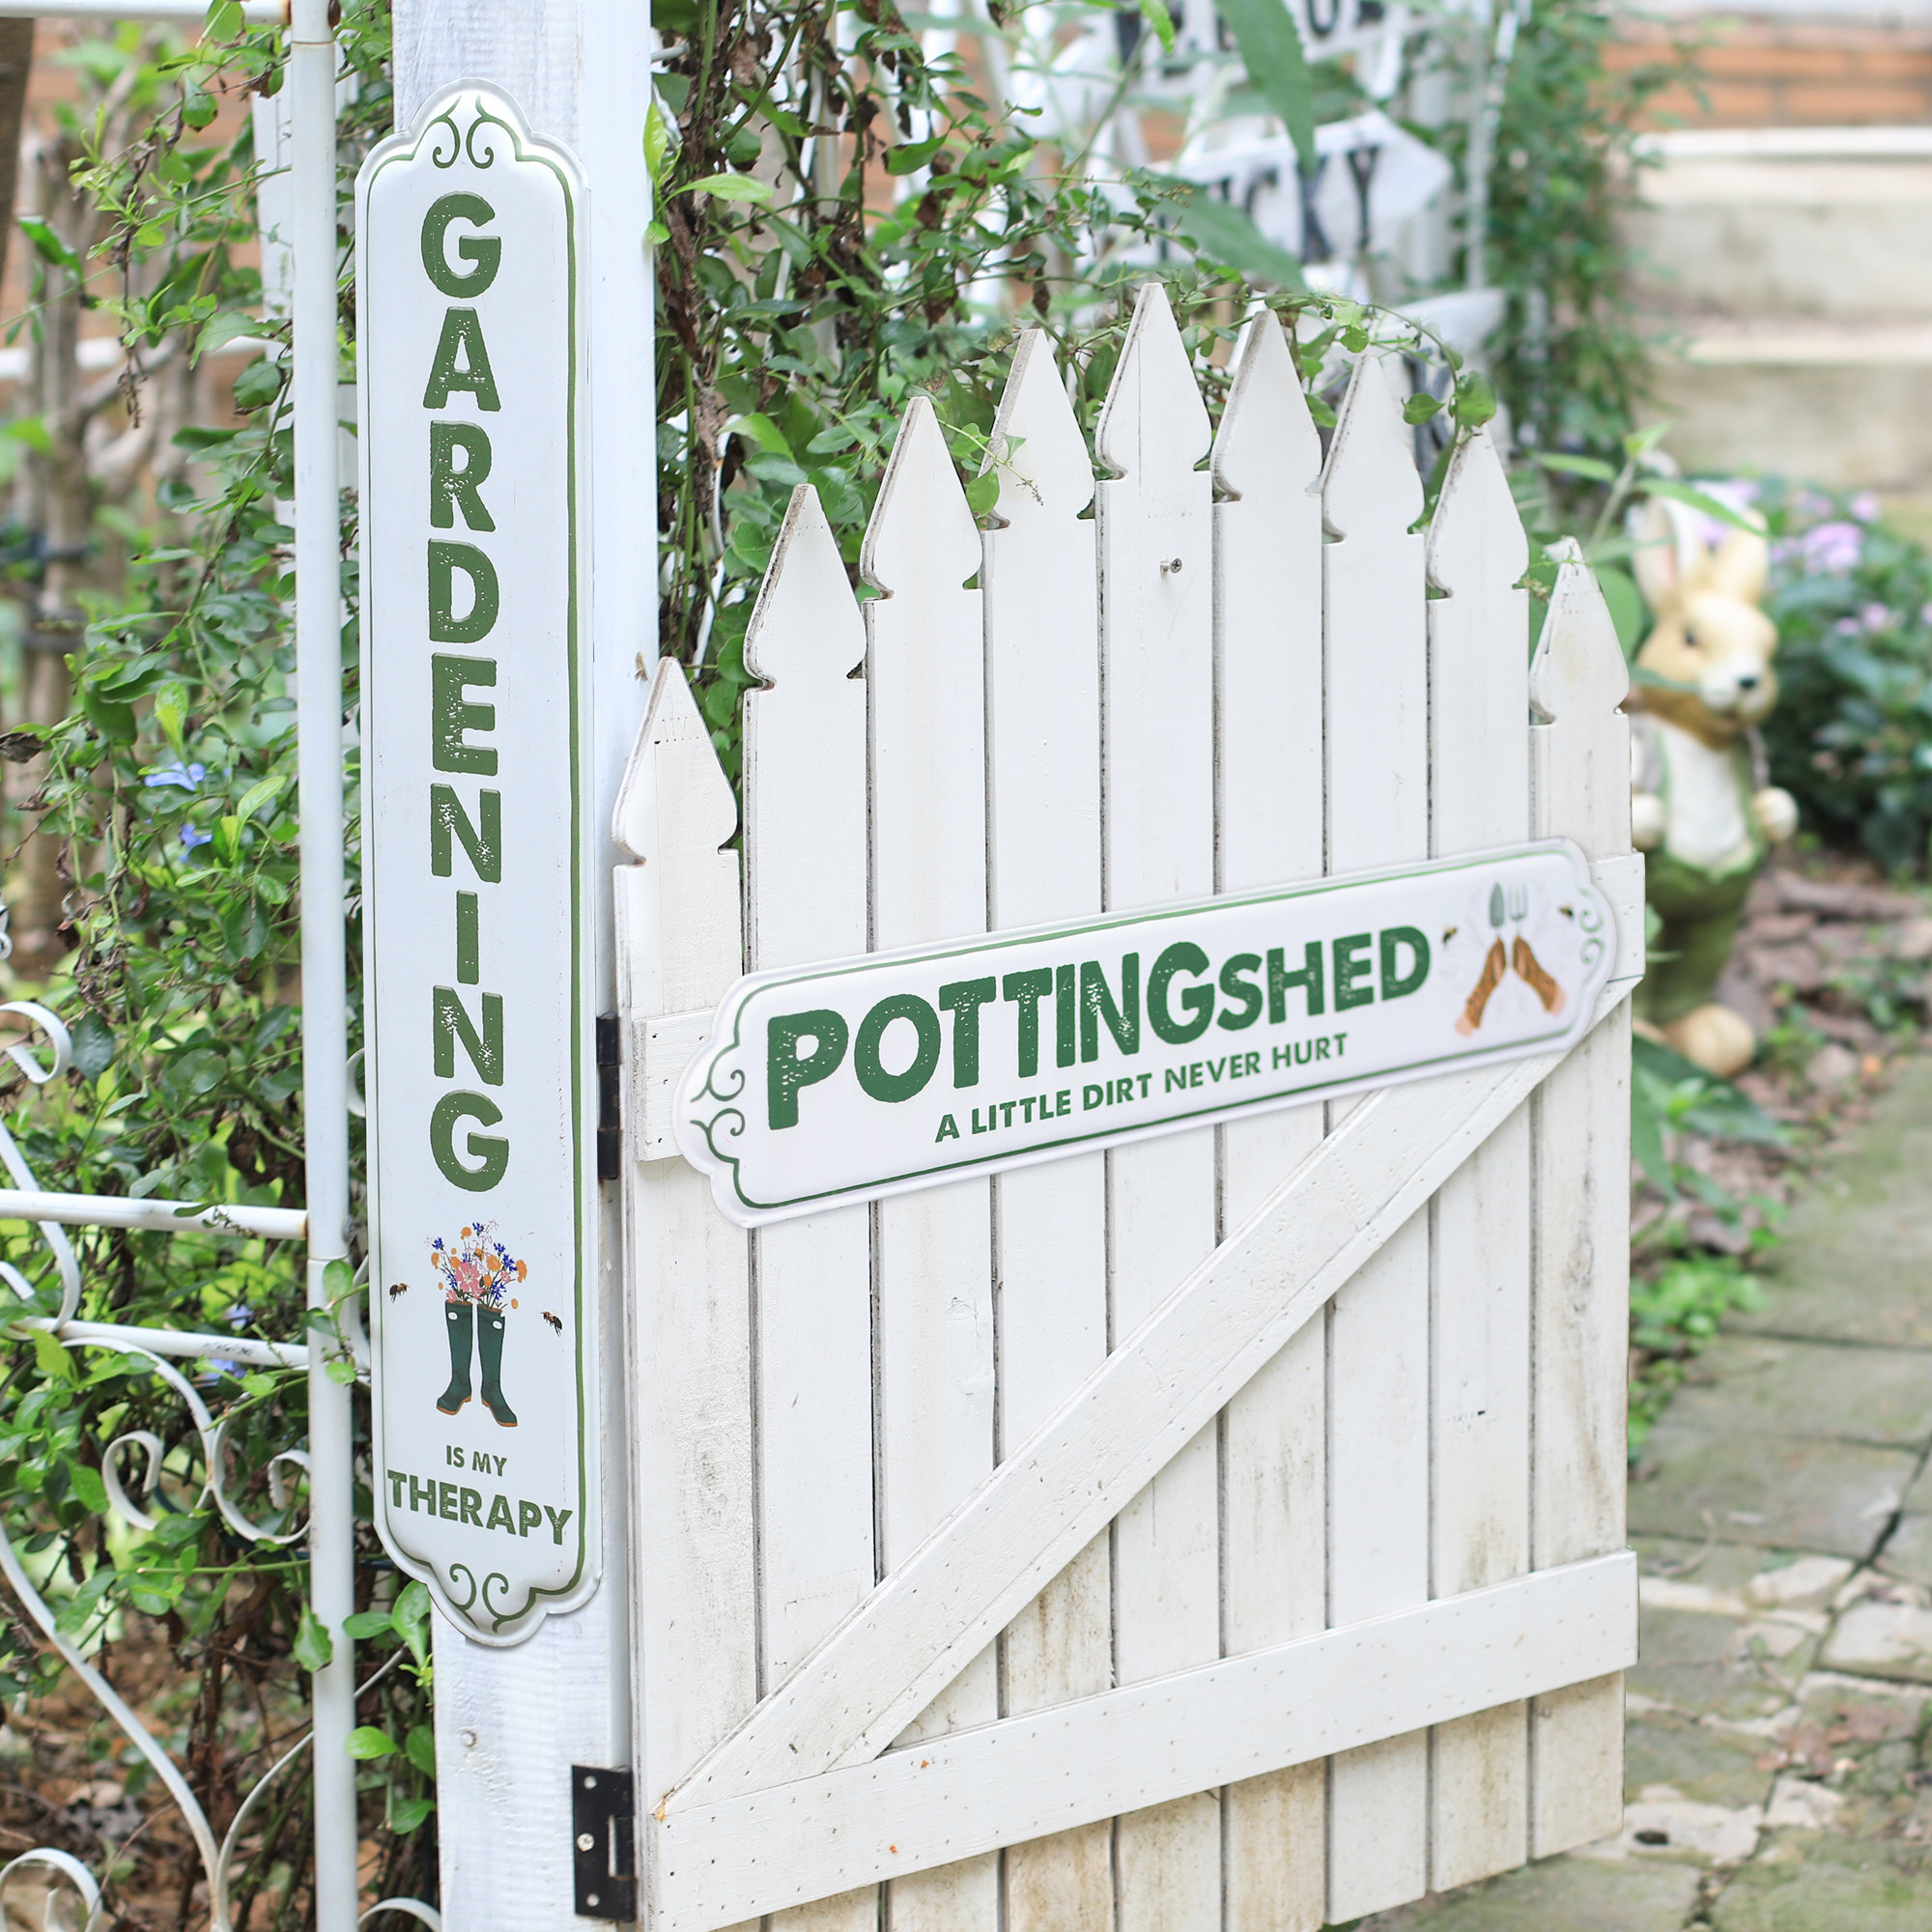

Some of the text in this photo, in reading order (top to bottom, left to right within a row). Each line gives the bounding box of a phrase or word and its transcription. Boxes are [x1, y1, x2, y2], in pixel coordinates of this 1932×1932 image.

[420, 193, 510, 1193] GARDENING
[934, 1031, 1349, 1144] A LITTLE DIRT NEVER HURT
[386, 1469, 573, 1547] THERAPY
[445, 1445, 508, 1477] IS MY
